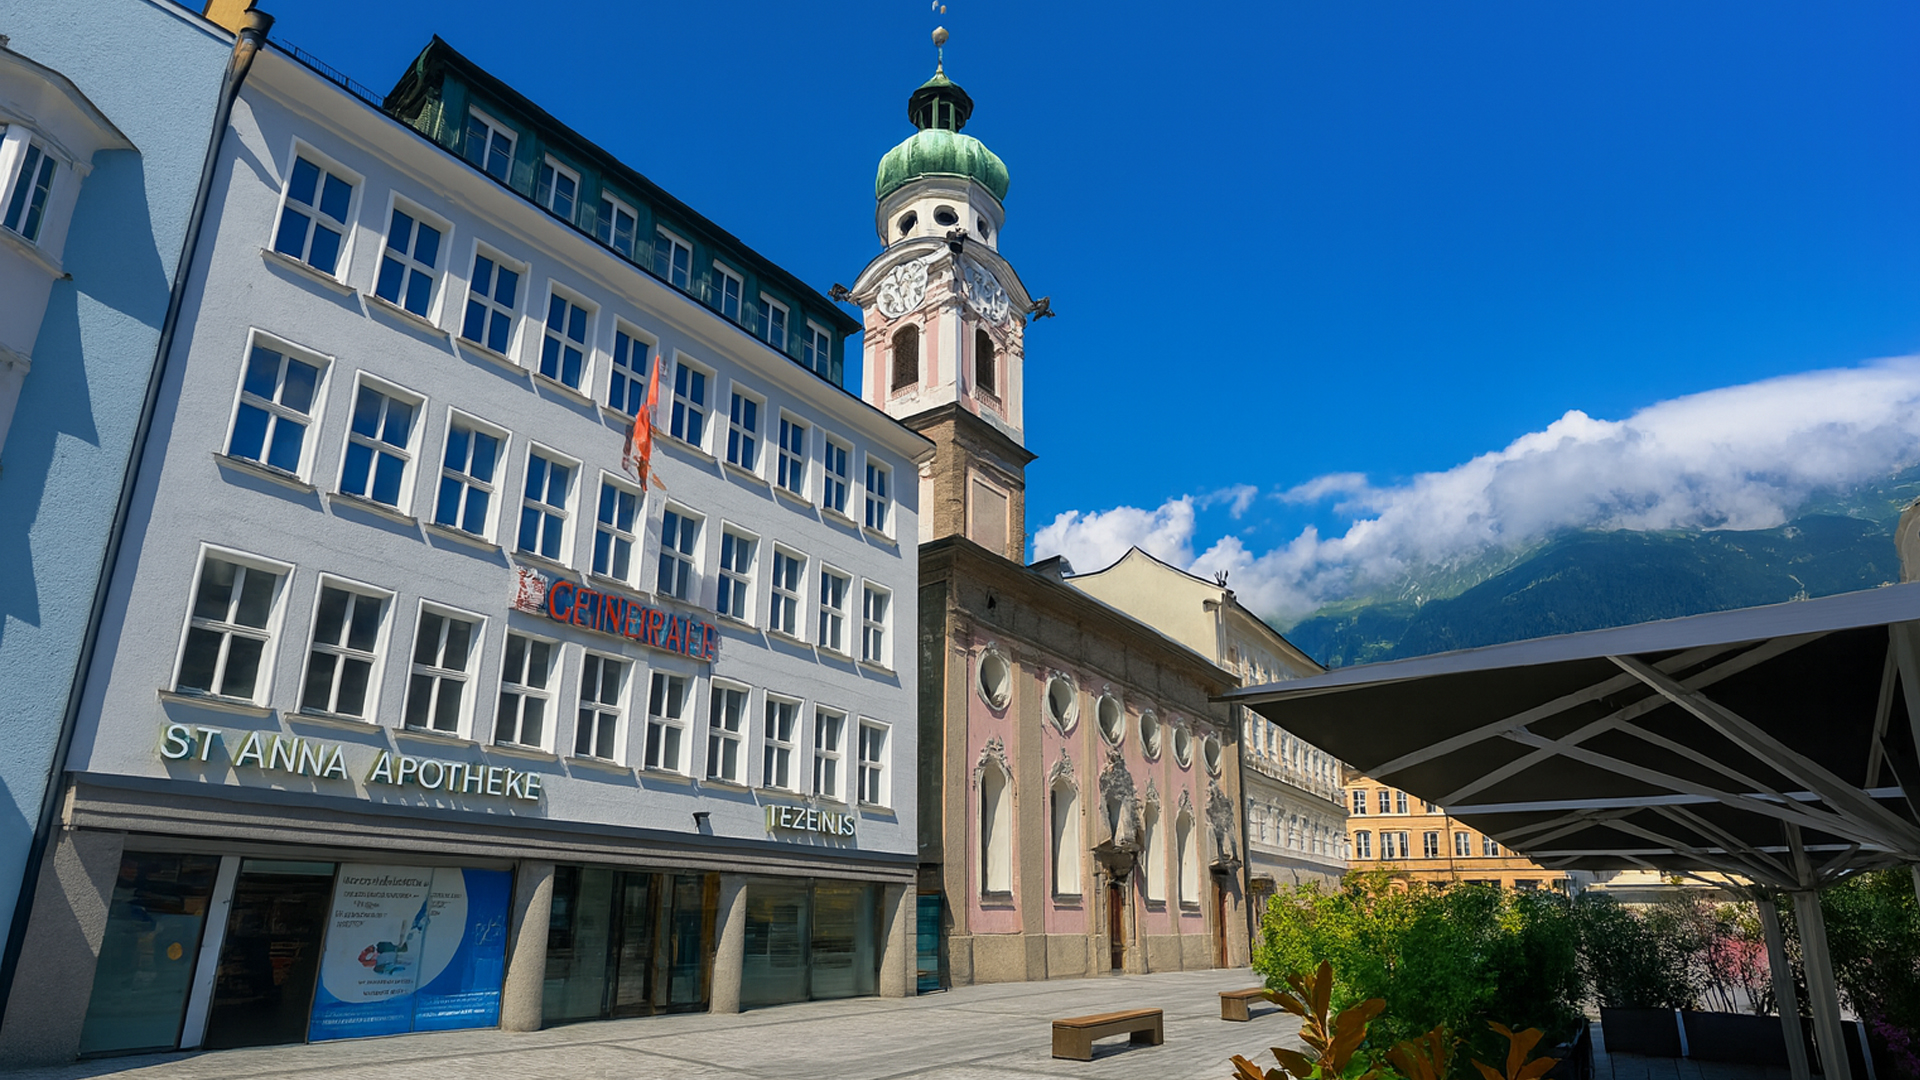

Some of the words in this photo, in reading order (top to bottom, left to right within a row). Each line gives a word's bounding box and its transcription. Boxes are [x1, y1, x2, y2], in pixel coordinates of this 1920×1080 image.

[160, 723, 222, 762] ST
[234, 731, 348, 780] ANNA
[370, 750, 542, 802] APOTHEKE
